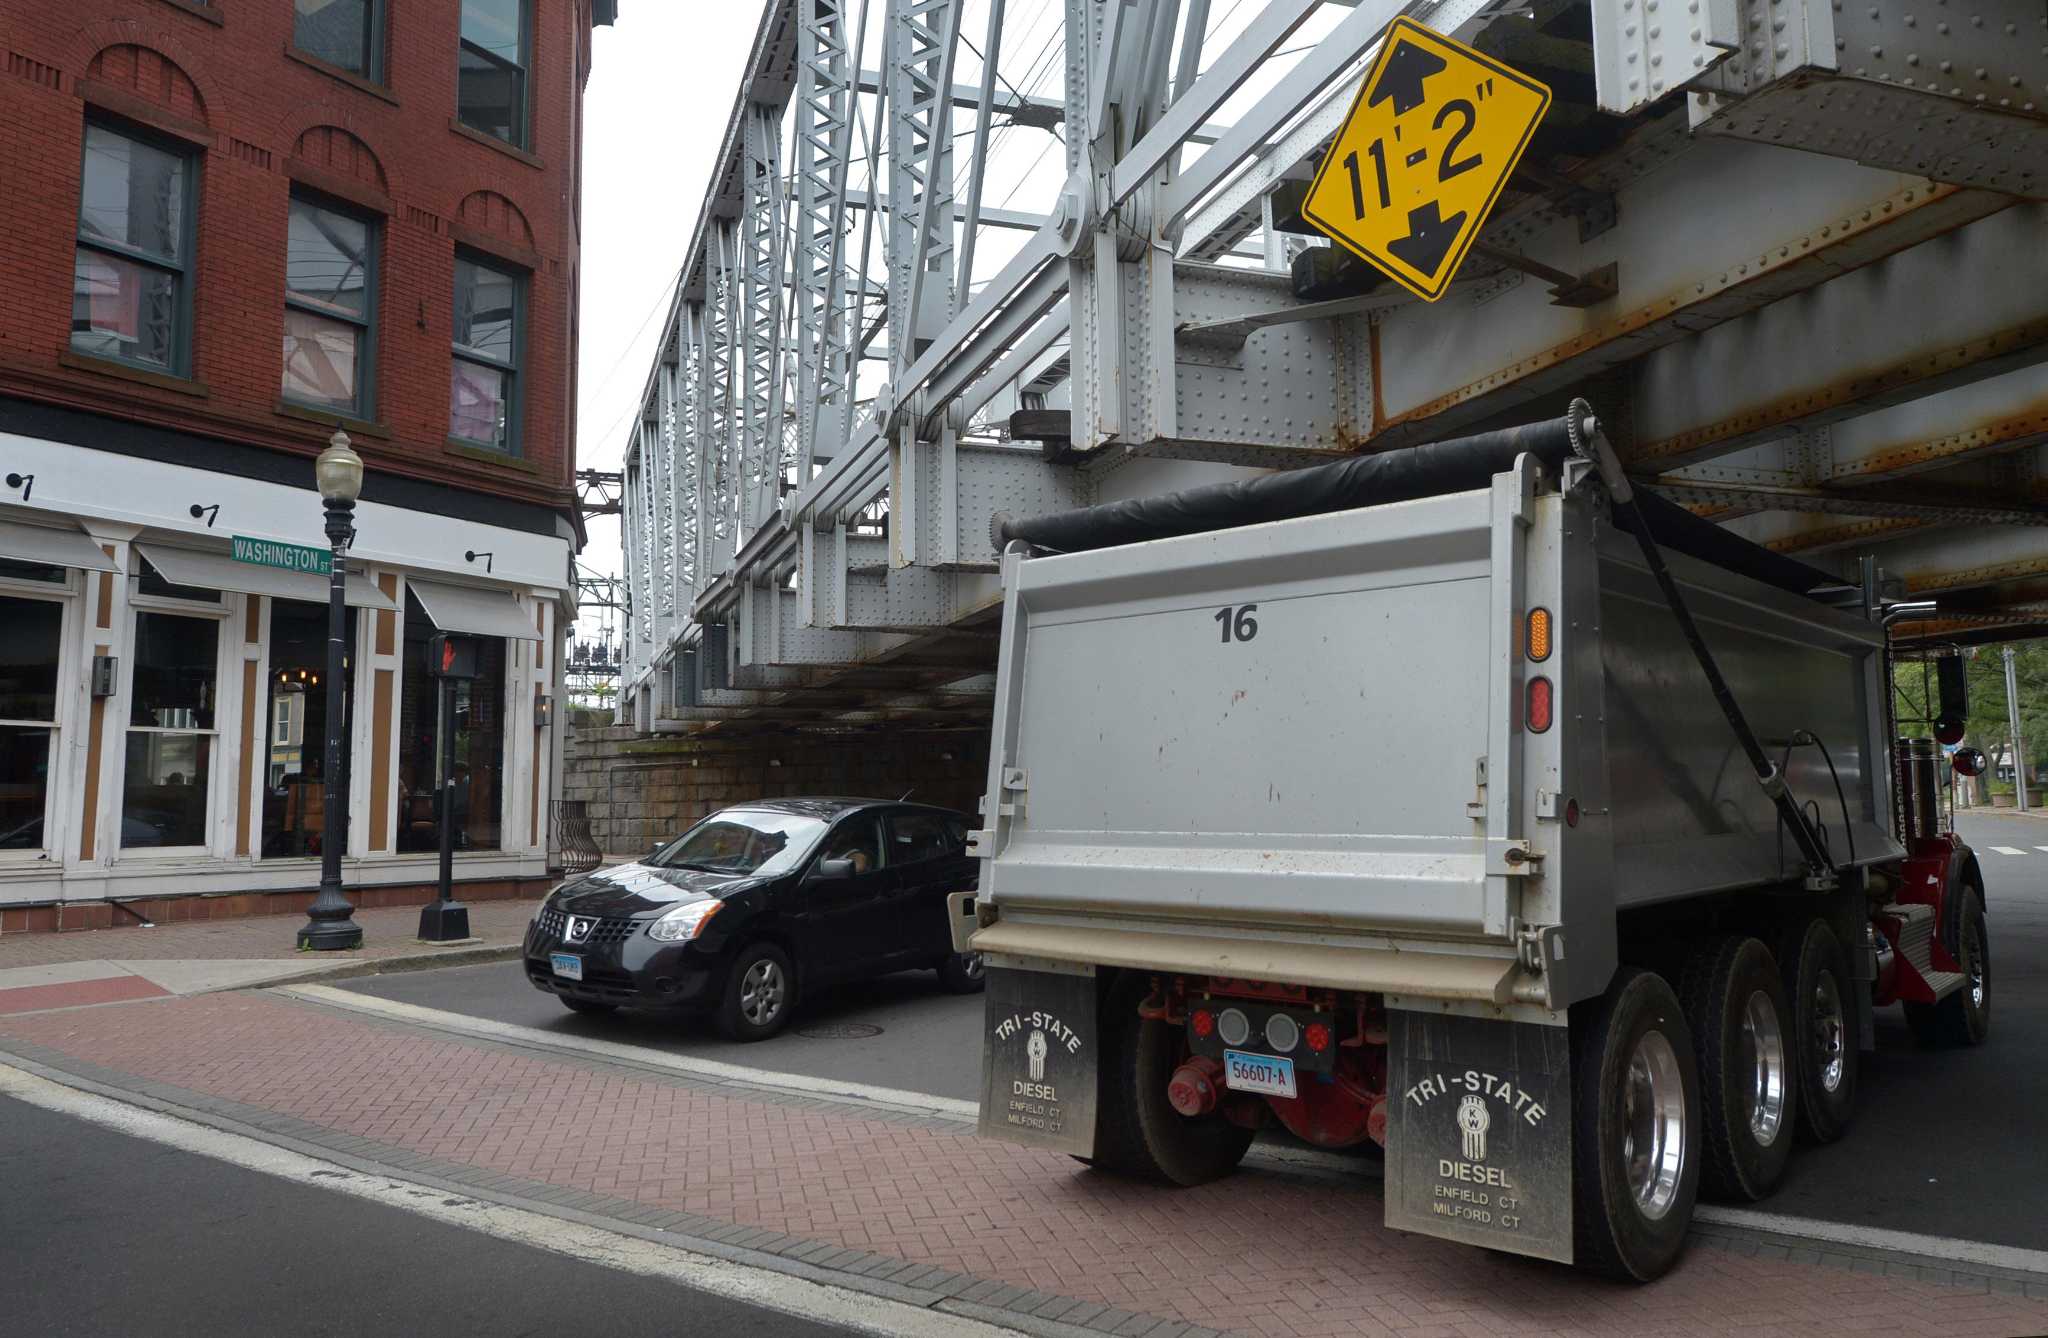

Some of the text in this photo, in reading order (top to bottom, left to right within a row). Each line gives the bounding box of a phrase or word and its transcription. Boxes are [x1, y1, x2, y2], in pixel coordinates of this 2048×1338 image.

[234, 539, 329, 571] WASHINGTON ST
[1214, 604, 1258, 643] 16
[995, 1011, 1082, 1054] TRI-STATE
[1013, 1081, 1058, 1101] DIESEL
[1406, 1071, 1547, 1126] TRI-STATE
[1439, 1159, 1513, 1189] DIESEL
[1499, 1196, 1518, 1210] CT
[1501, 1215, 1521, 1229] CT
